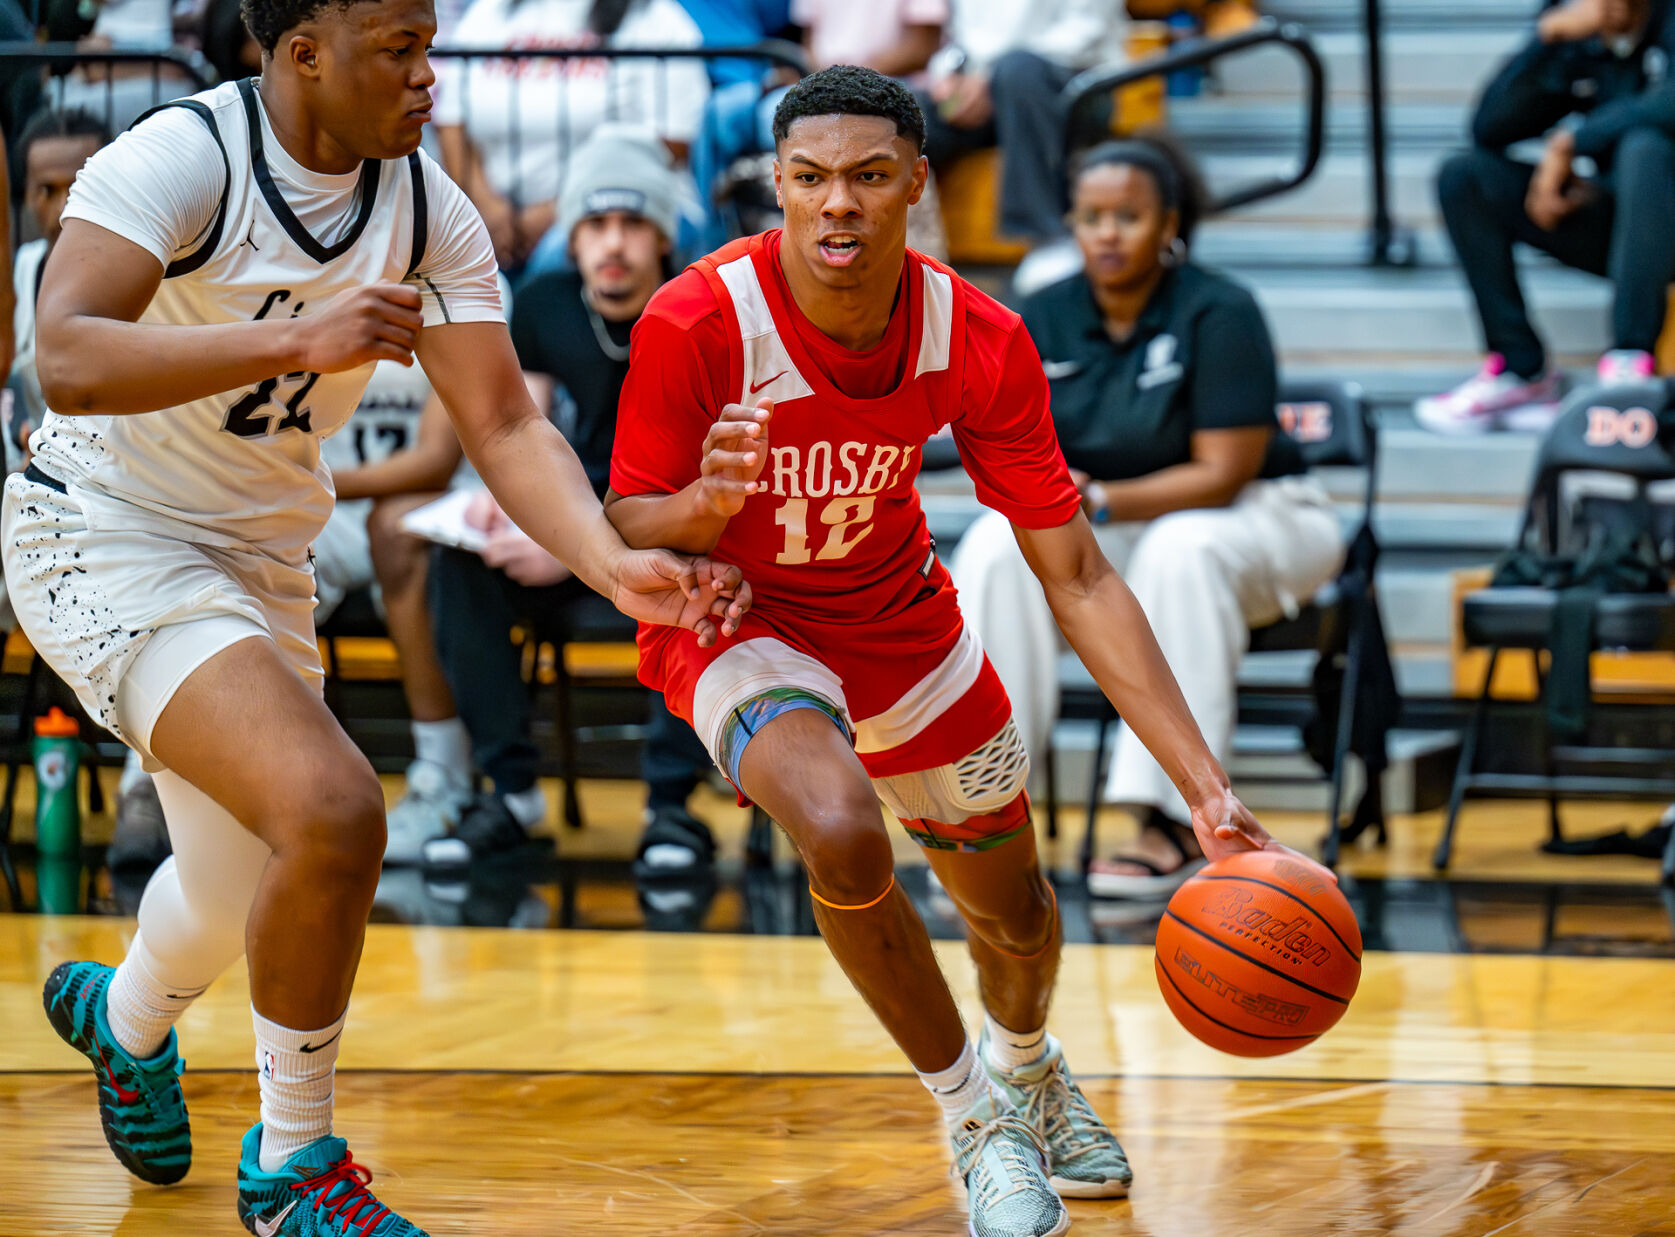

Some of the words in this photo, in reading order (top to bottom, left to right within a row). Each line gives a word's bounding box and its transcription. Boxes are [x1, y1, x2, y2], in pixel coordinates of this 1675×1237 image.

[757, 440, 917, 498] ROSBY
[775, 495, 877, 565] 12
[1201, 887, 1331, 967] Baden
[1219, 922, 1301, 965] PERFECTION
